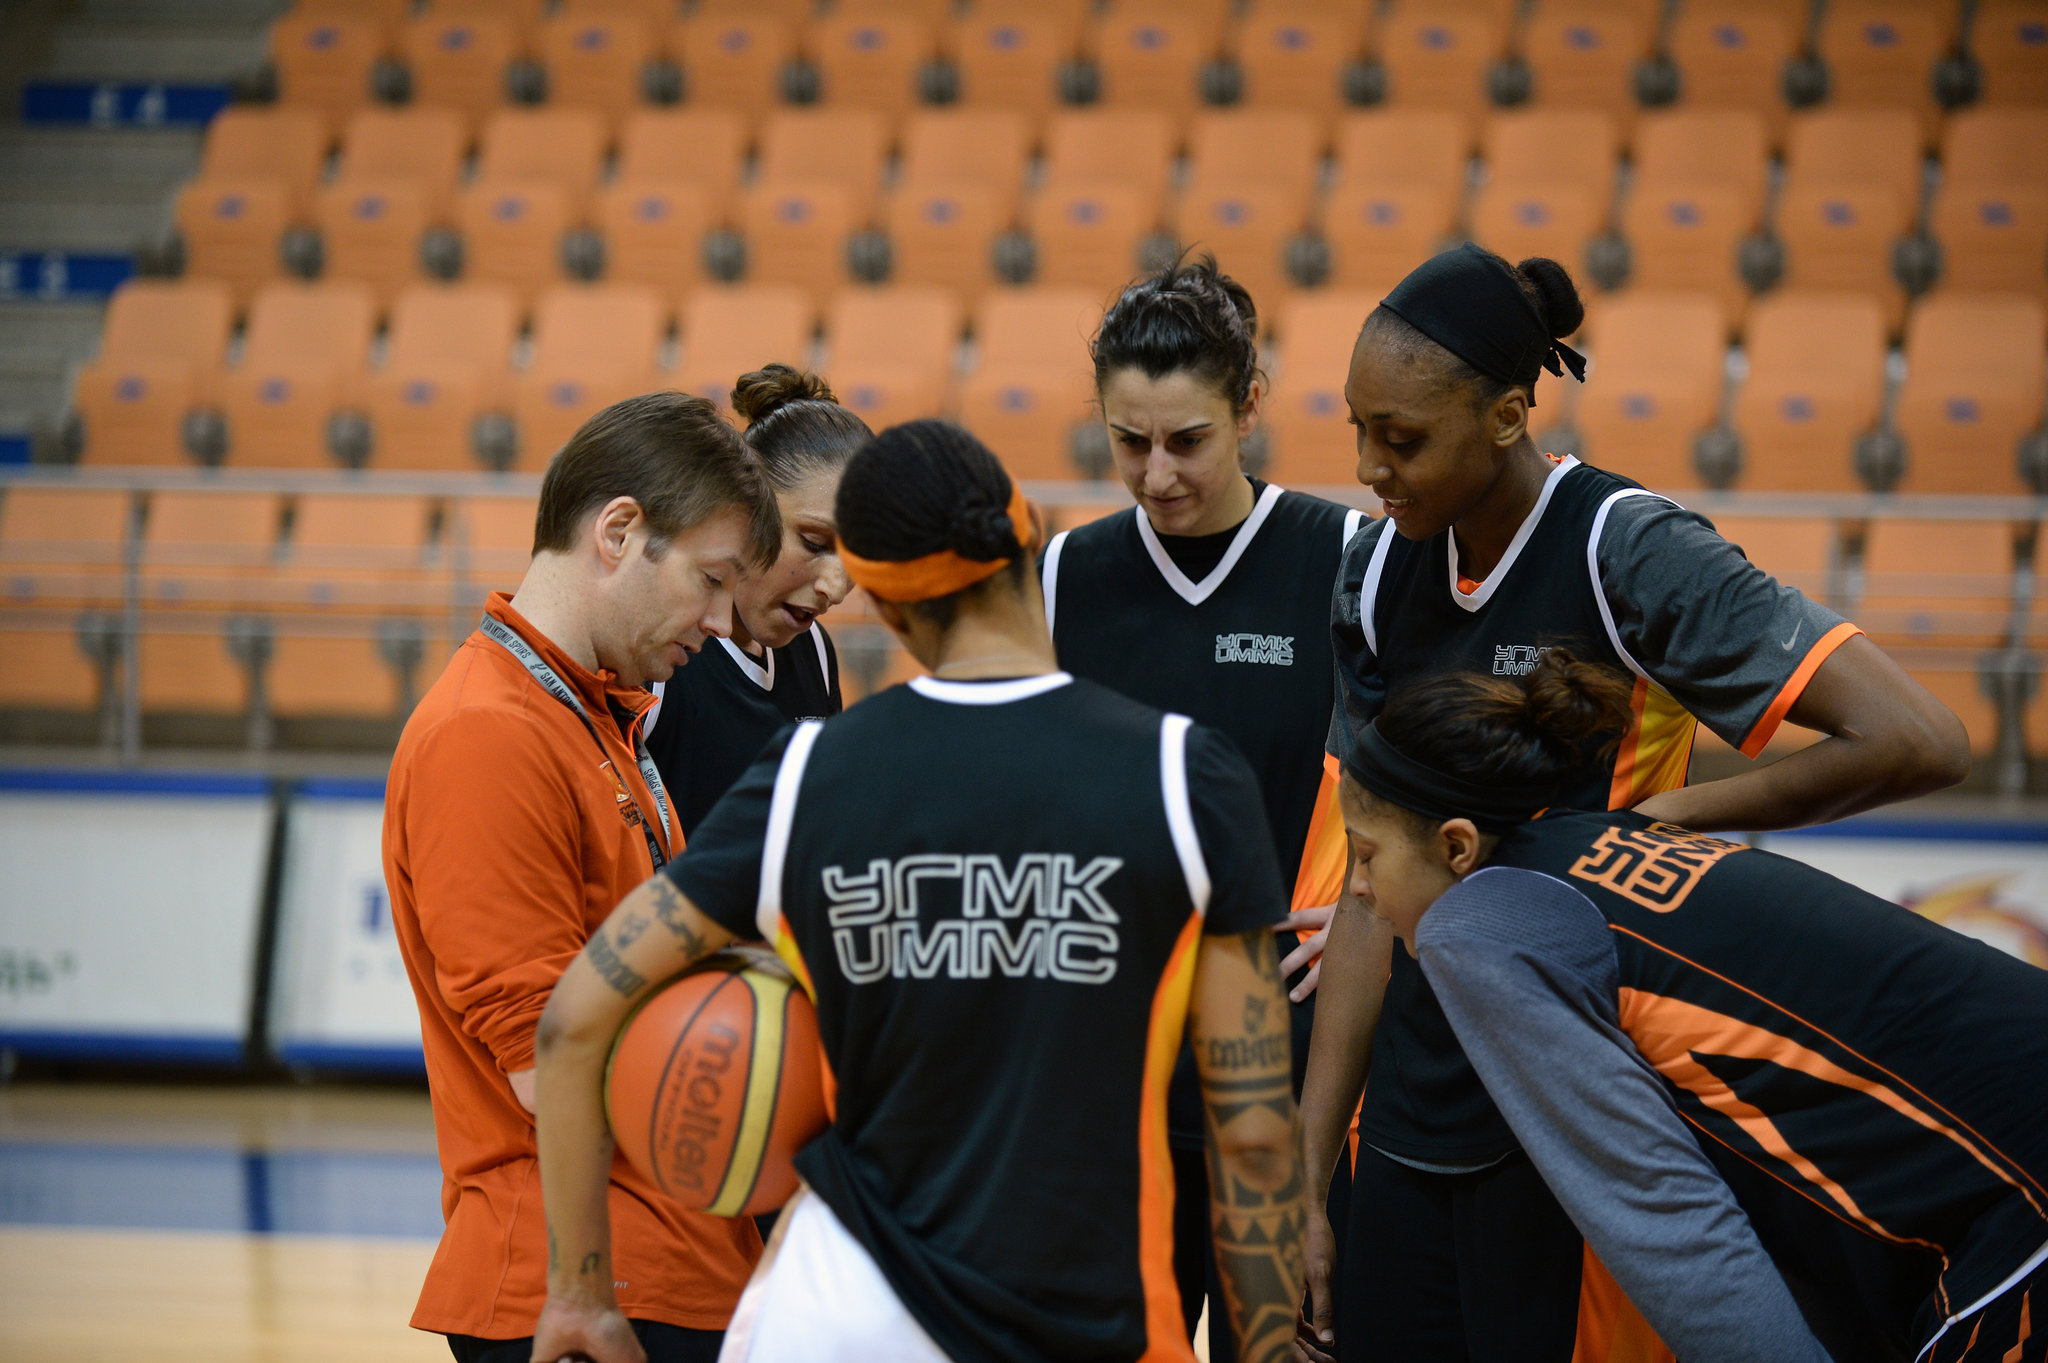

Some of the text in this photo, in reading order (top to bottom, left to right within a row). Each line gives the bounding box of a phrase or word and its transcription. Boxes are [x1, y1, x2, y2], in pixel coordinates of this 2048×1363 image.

[490, 625, 513, 643] ANTONIO
[509, 640, 531, 658] SPURS
[1216, 633, 1294, 652] УГМК
[1495, 645, 1552, 661] УГМ
[1215, 648, 1293, 666] UMMC
[1493, 661, 1541, 676] UMM
[540, 672, 578, 711] SAN ANTONIO
[644, 768, 661, 790] SPURS
[822, 854, 1123, 927] УГМК
[834, 919, 1119, 985] UMMC
[674, 1024, 740, 1190] molten
